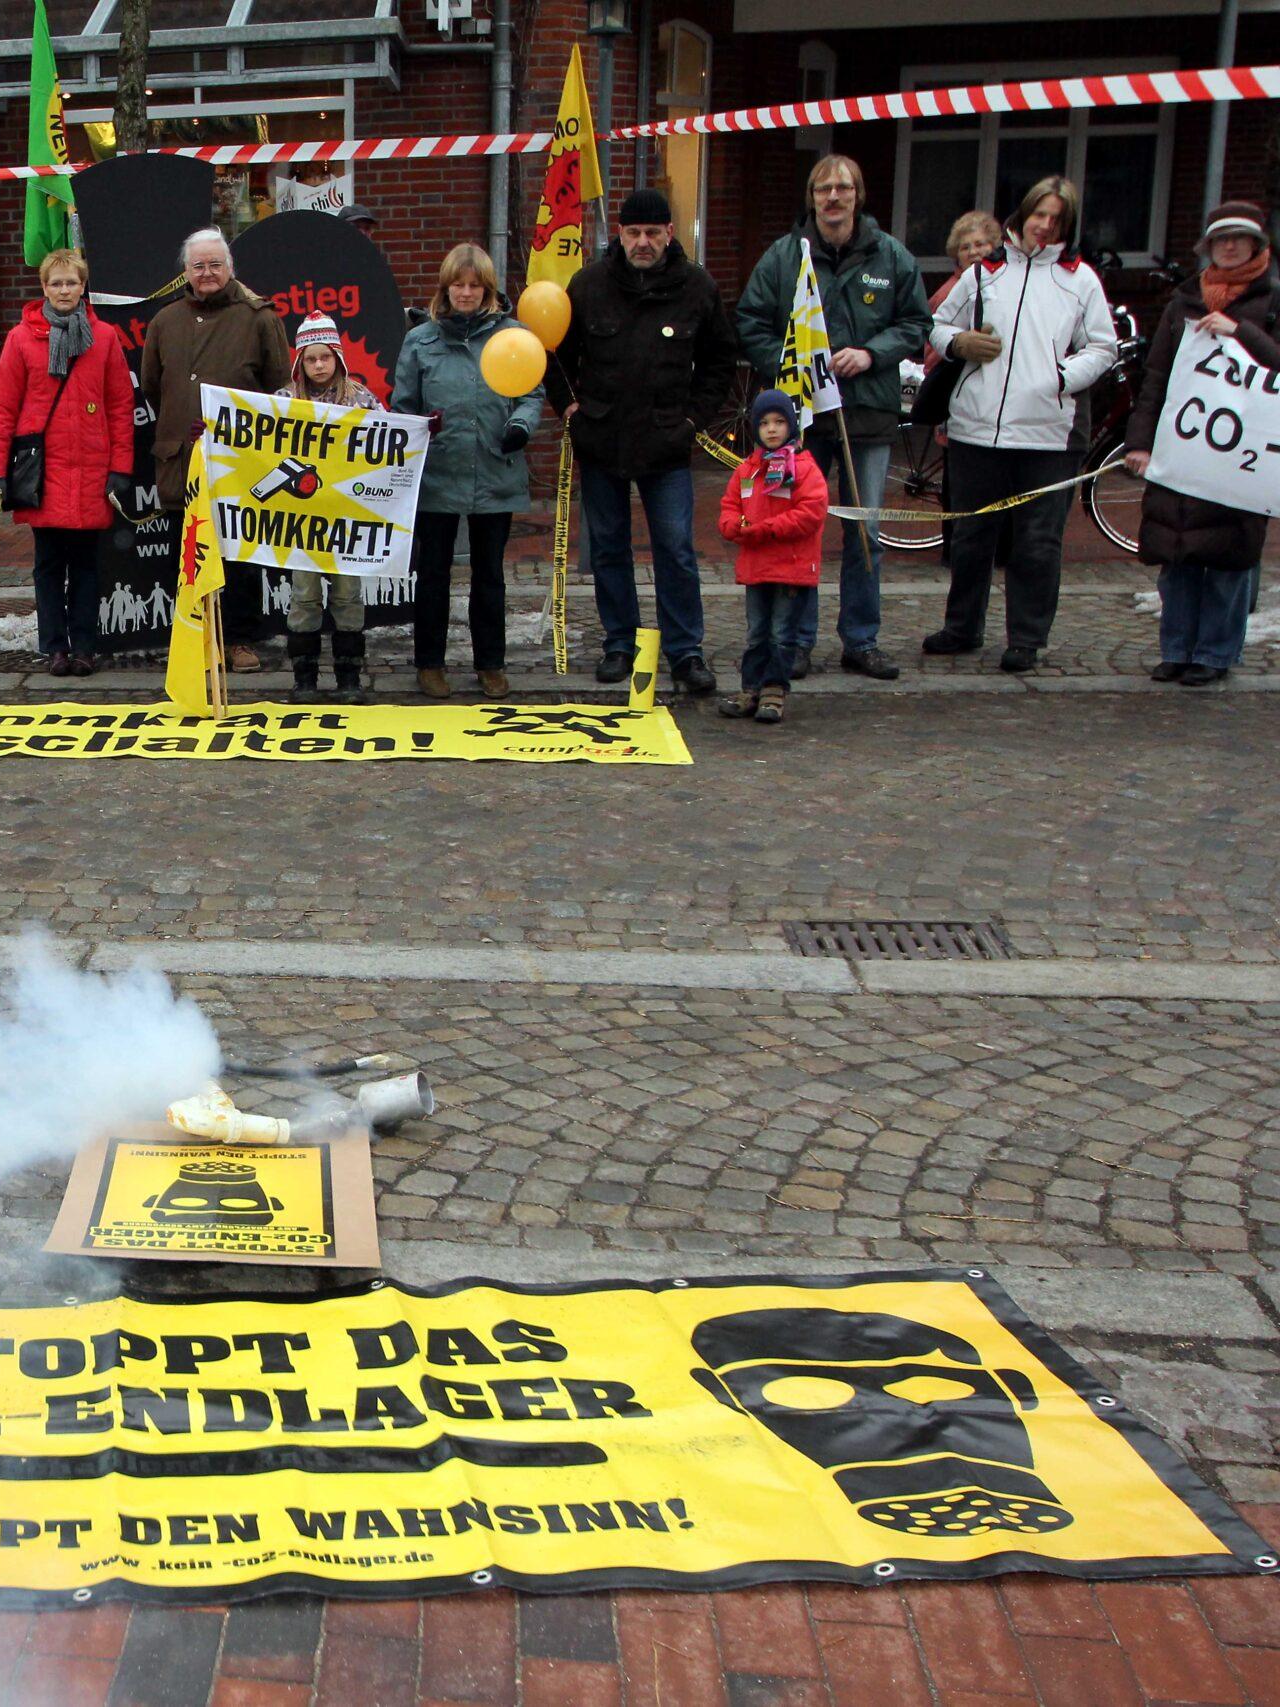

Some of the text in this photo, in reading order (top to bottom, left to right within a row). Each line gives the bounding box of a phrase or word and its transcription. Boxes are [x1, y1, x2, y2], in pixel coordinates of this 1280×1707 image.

[869, 276, 890, 287] BUND
[271, 280, 361, 318] stieg
[213, 405, 341, 460] ABPFIFF
[346, 421, 409, 467] FÜR
[364, 487, 394, 497] BUND
[341, 556, 384, 564] www.bund.net
[91, 1227, 329, 1243] CO2-ENDLAGER
[103, 1238, 315, 1253] STOPPT DAS
[346, 1319, 568, 1370] DAS
[117, 1513, 259, 1546] DEN
[285, 1497, 696, 1542] WAHNSINN!
